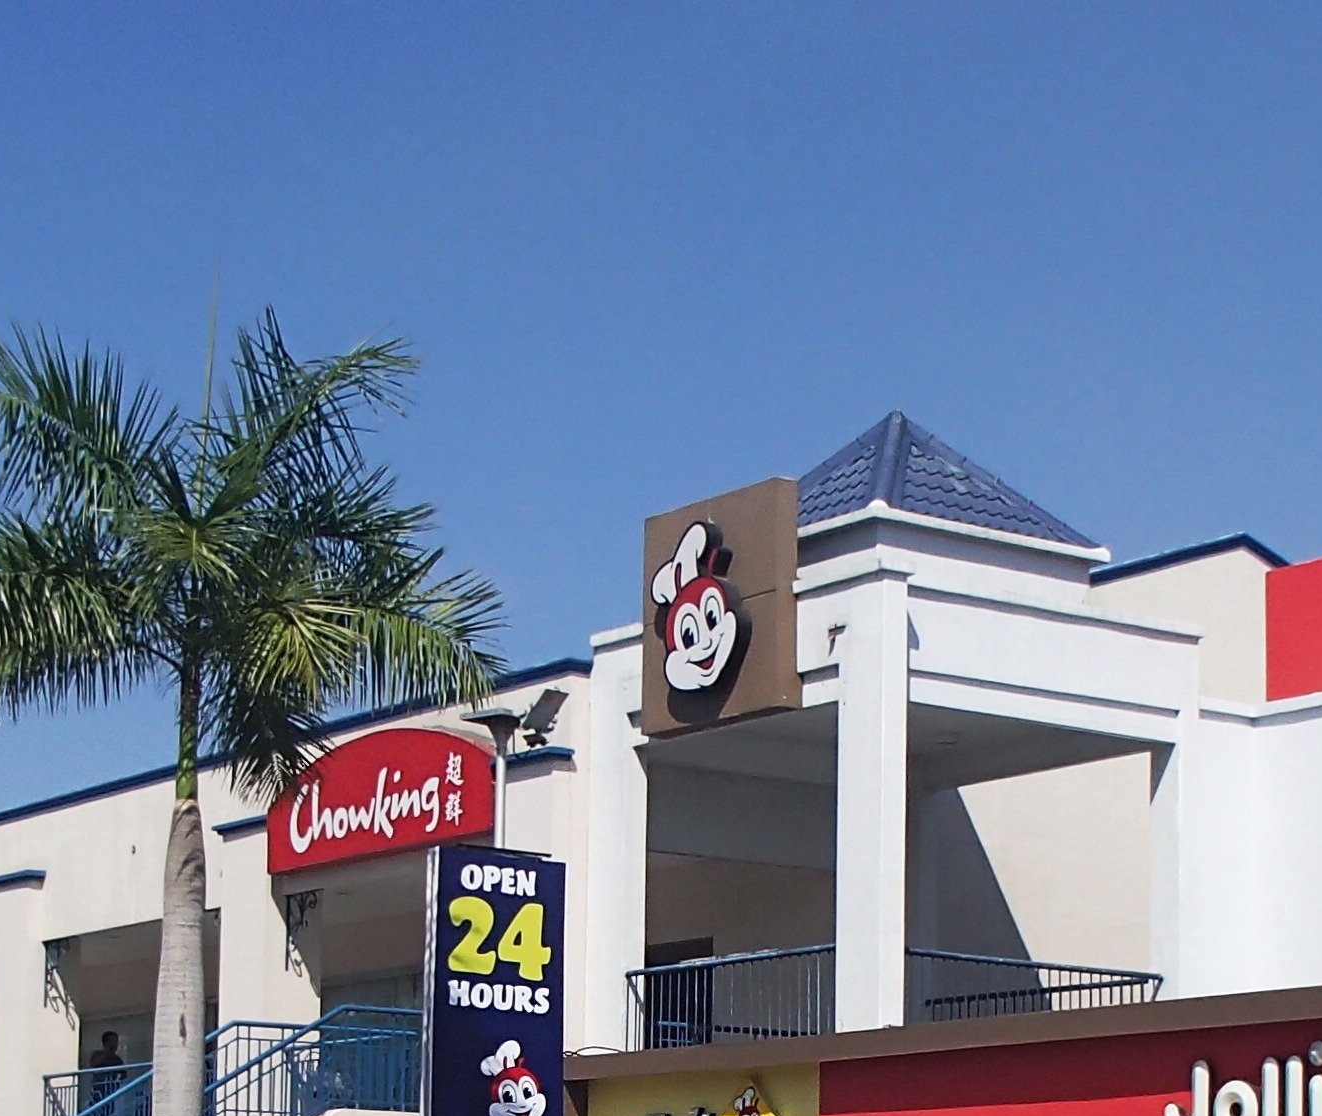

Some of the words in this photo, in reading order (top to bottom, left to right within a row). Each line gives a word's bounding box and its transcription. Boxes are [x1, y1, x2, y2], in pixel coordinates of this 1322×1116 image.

[289, 767, 440, 854] Chowking
[460, 864, 537, 897] OPEN
[448, 896, 552, 982] 24
[447, 979, 550, 1015] HOURS
